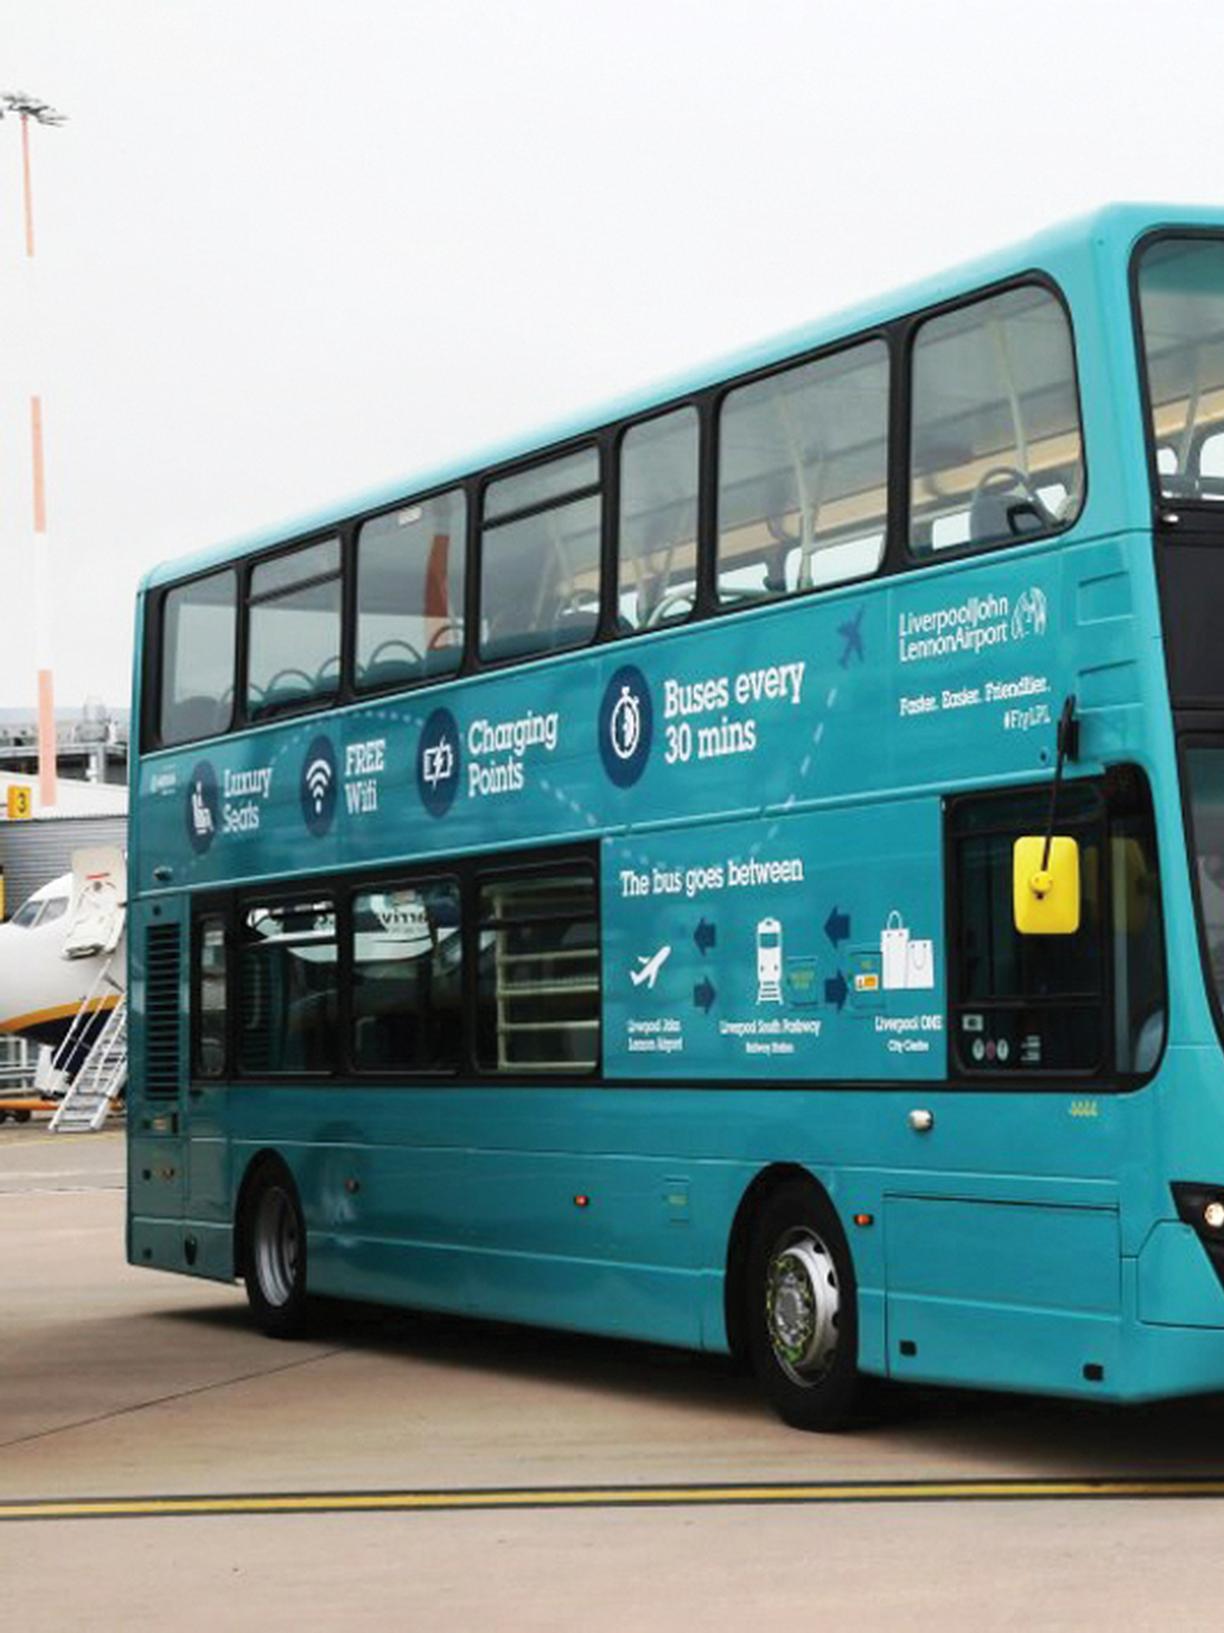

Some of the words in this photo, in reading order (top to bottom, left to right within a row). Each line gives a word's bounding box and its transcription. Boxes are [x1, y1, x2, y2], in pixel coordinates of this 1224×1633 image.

[899, 622, 1008, 662] LennonAirport
[664, 677, 729, 719] Buses
[735, 661, 805, 704] every
[467, 709, 559, 757] Charging
[664, 722, 692, 764] 30
[698, 716, 756, 759] mins
[344, 740, 386, 776] FREE
[467, 755, 525, 798] Points
[223, 767, 273, 799] Luxury
[221, 801, 260, 833] Seats
[619, 869, 650, 898] The
[651, 867, 684, 894] bus
[686, 865, 724, 898] goes
[727, 856, 804, 887] between
[874, 1015, 918, 1034] Liverpool
